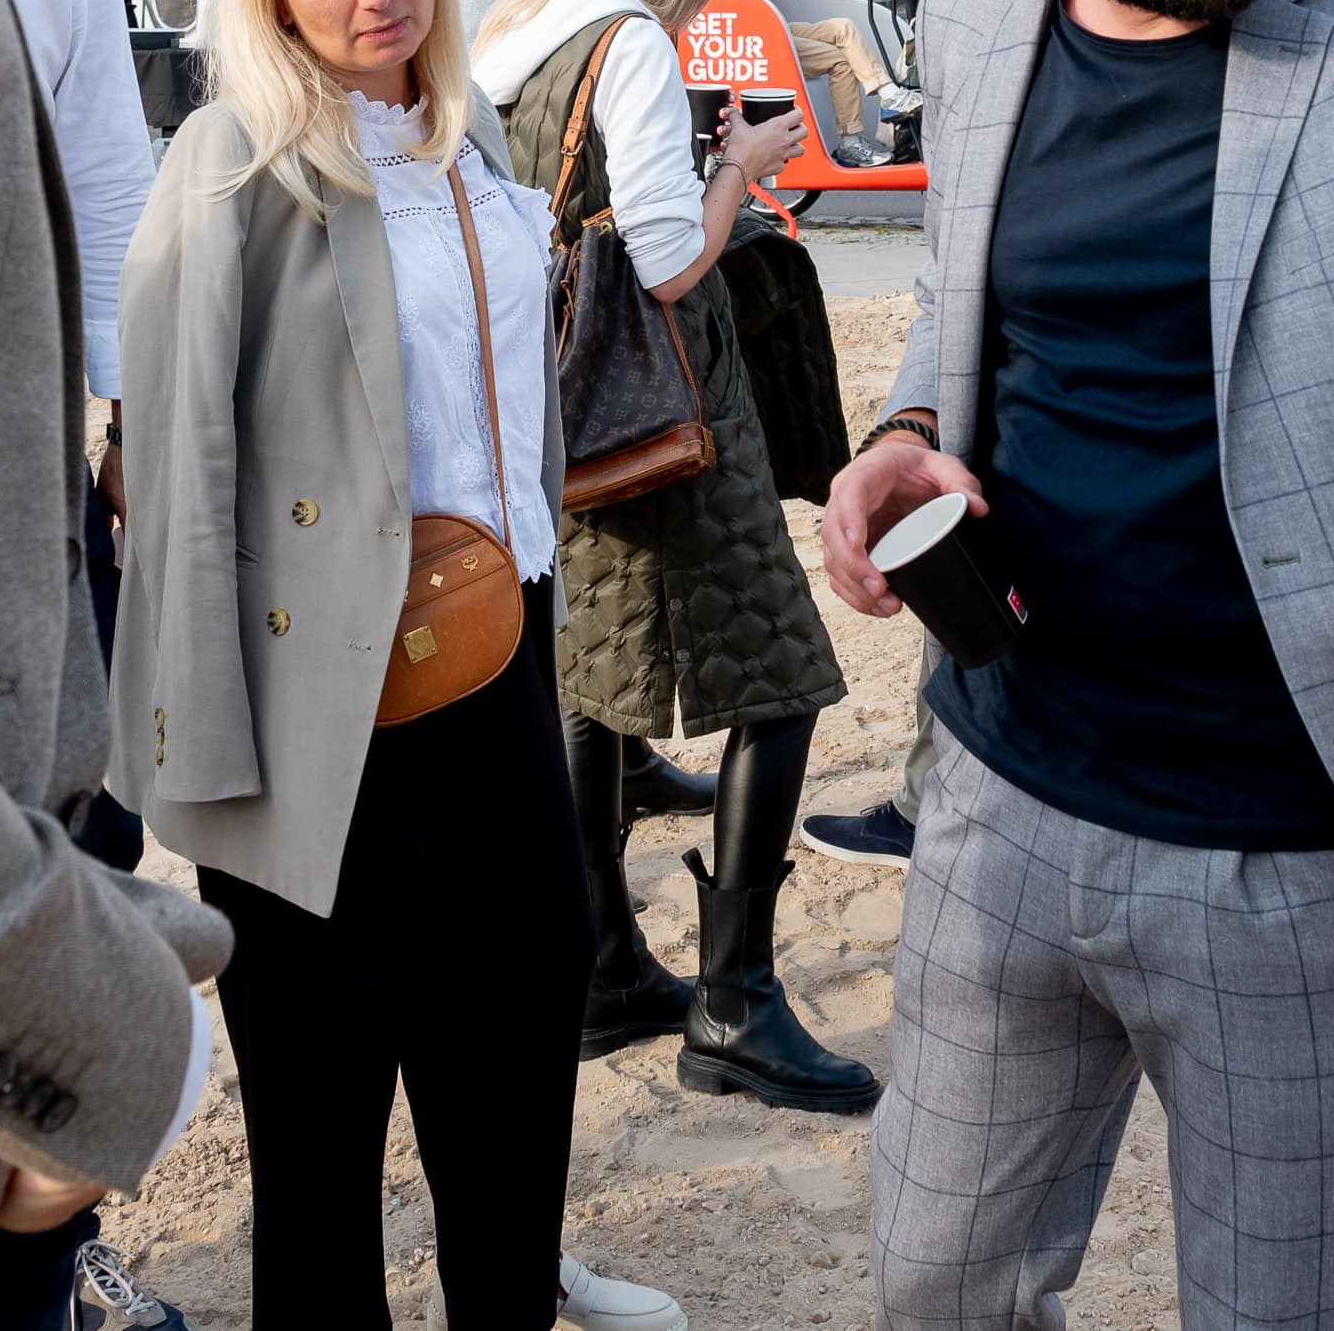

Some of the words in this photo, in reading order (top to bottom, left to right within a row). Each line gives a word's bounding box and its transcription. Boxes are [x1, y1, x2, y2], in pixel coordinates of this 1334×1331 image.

[688, 12, 738, 35] GET
[687, 35, 764, 58] YOUR
[687, 58, 769, 82] GUIDE
